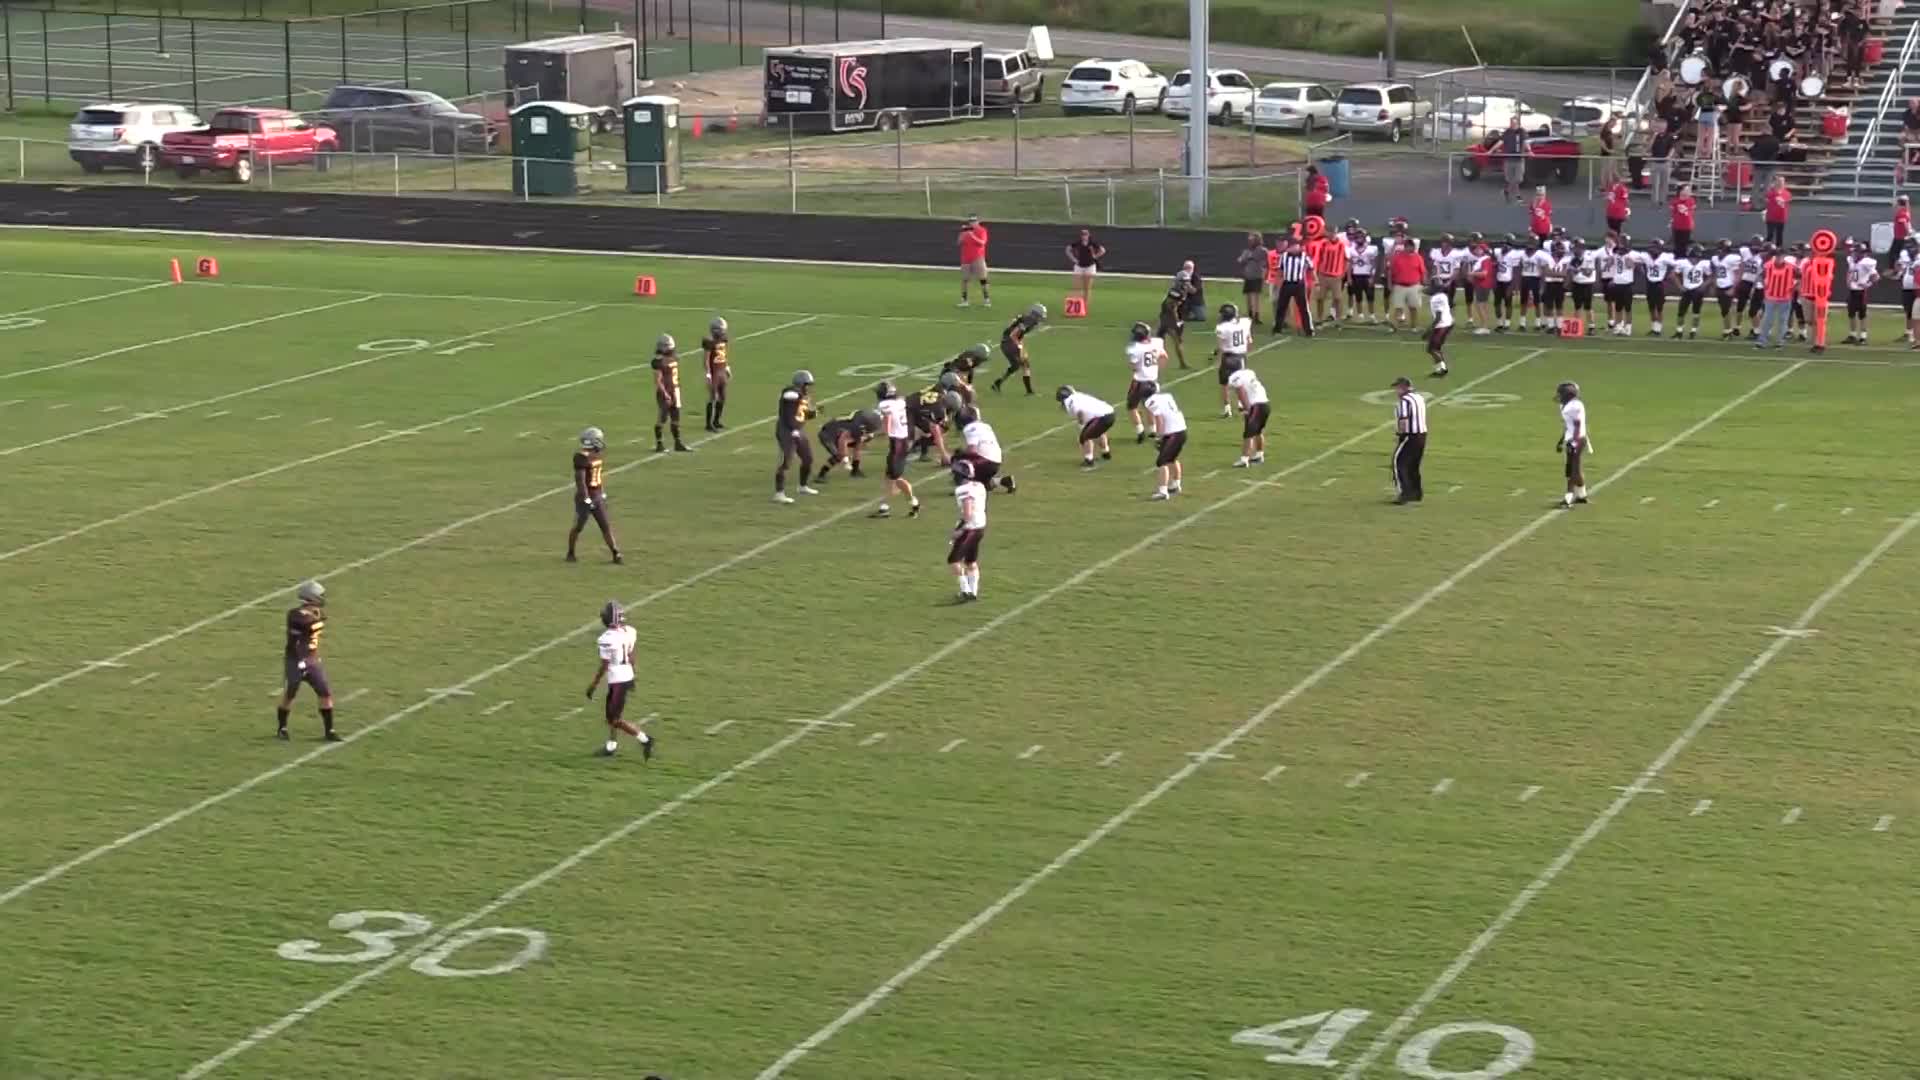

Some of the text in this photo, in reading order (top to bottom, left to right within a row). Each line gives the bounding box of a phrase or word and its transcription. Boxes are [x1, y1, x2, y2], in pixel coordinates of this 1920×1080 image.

[199, 259, 211, 273] G
[637, 279, 651, 293] 10
[1065, 300, 1081, 315] 20
[1562, 318, 1580, 335] 30
[1232, 329, 1245, 348] 81
[276, 909, 547, 977] 30
[1229, 1007, 1536, 1080] 40
